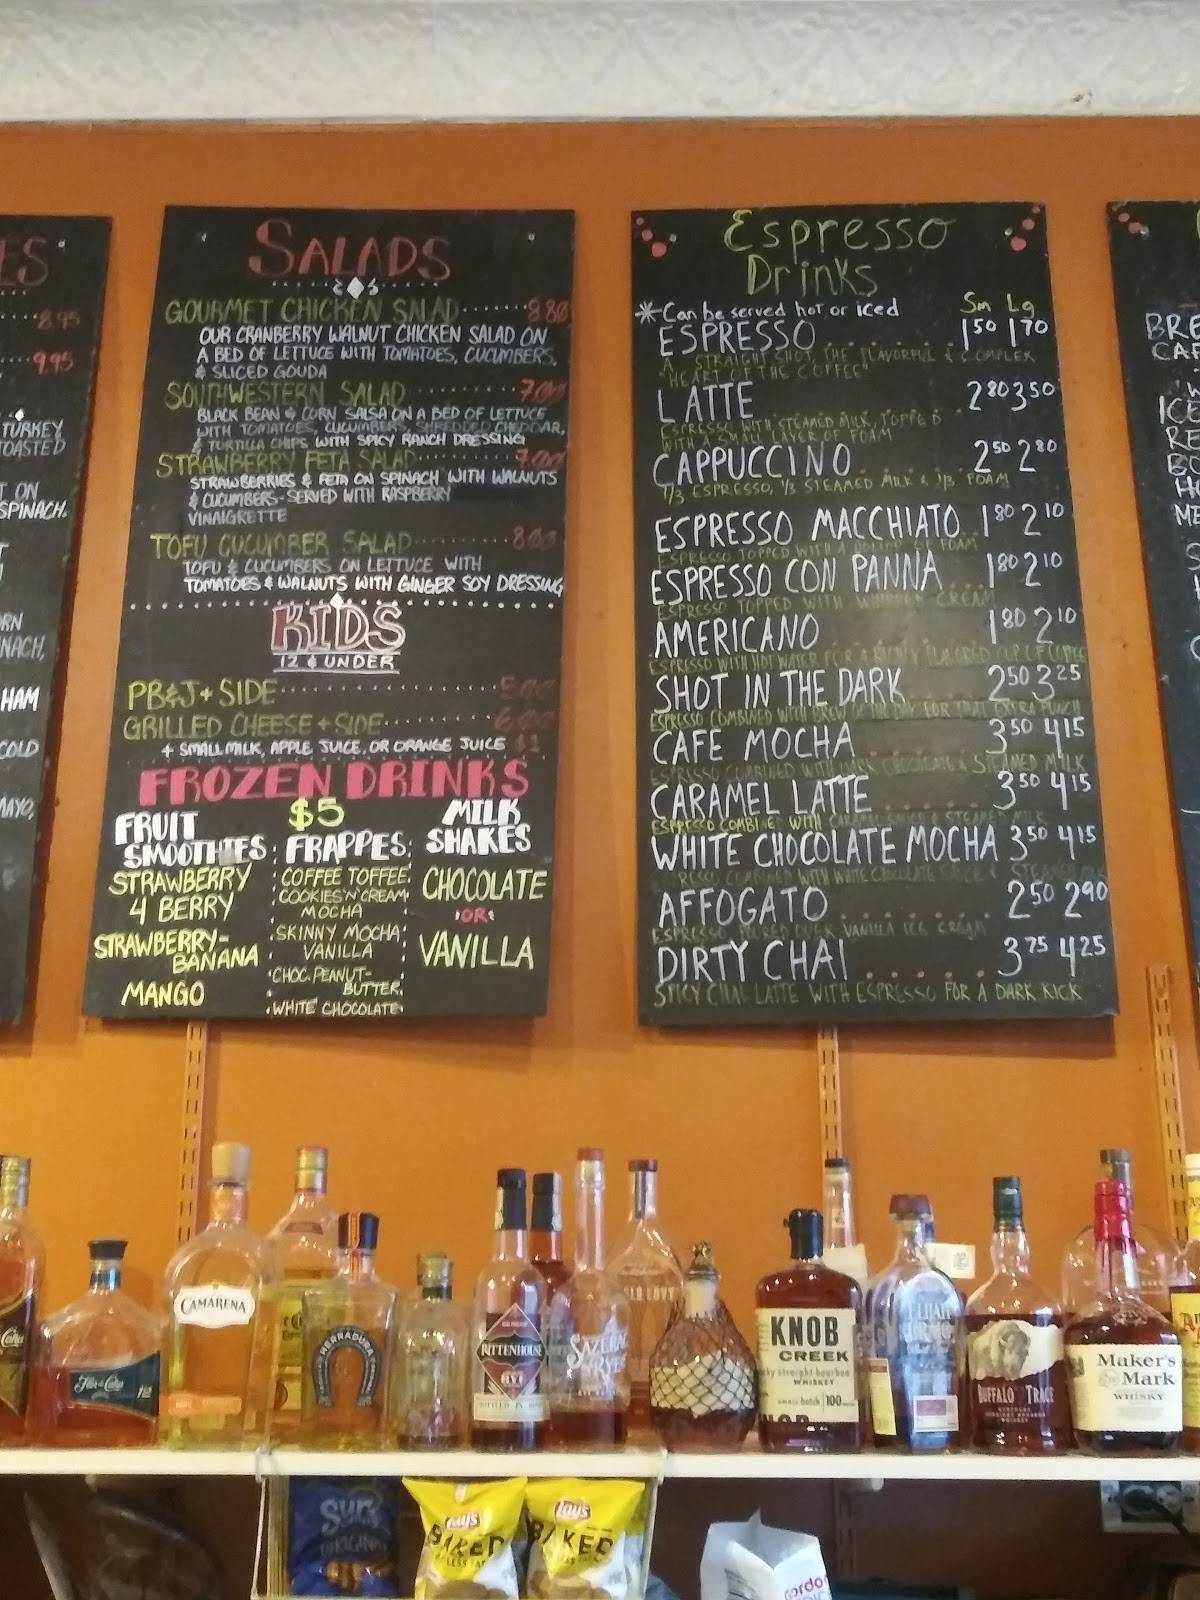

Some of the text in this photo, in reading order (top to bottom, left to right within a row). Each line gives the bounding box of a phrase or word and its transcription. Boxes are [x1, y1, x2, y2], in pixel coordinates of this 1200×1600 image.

[249, 217, 450, 281] SALADS
[723, 209, 957, 264] Espresso
[748, 253, 878, 298] Drinks
[165, 298, 271, 325] GOURMET
[280, 297, 384, 323] CHICKEN
[703, 301, 725, 320] be
[730, 302, 786, 318] served
[795, 301, 824, 317] hot
[830, 304, 848, 317] or
[856, 298, 900, 317] iced
[960, 291, 1035, 319] Sm Lg
[200, 324, 548, 347] OUR CRANBERRY WALNUT CHICKEN SALAD ON
[659, 320, 816, 357] ESPRESSO
[214, 345, 558, 367] BED LETTUCE WITH TOMATOES, CUCUMBERS,
[211, 365, 328, 380] SLICED GOUDA
[165, 380, 406, 410] SOUTHWESTERN SALAD
[658, 381, 754, 423] LATTE
[357, 433, 526, 448] SPICY RANCH DRESSING
[156, 452, 296, 479] STRAWBERRY
[305, 450, 351, 476] FETA
[653, 441, 851, 487] CAPPUCCINO
[190, 469, 558, 490] STRAWBERRIES FETA ON SPINACH WITH WALNUTS
[287, 485, 451, 505] SERVED WITH RASPBERRY
[188, 509, 288, 526] VINAIGRETTE
[655, 503, 960, 553] ESPRESSO MACCHIATO
[150, 530, 413, 560] TOFU CUCUMBER SALAD
[183, 555, 482, 576] TOFU CUCUMBERS ON LETTUCE WITH
[651, 549, 943, 606] ESPRESSO CON PANNA
[184, 574, 563, 598] TOMATOES WALNUTS WITH GINGER SOY DRESSING
[271, 602, 406, 652] KIDS
[655, 613, 820, 659] AMERICANO
[324, 654, 395, 670] UNDER
[0, 687, 40, 711] HAM
[128, 677, 278, 710] PB&J SIDE
[654, 667, 906, 714] SHOT IN THE DARK
[123, 711, 384, 740] GRILLED CHEESE SIDE
[180, 741, 222, 757] SMALL
[271, 740, 313, 755] APPLE
[319, 739, 366, 755] JUICE,
[370, 739, 389, 754] OR
[394, 737, 452, 752] ORANGE
[460, 736, 506, 751] JUICE
[653, 721, 856, 765] CAFE MOCHA
[139, 758, 529, 806] FROZEN DRINKS
[651, 774, 872, 820] CARAMEL LATTE
[288, 797, 345, 831] $5
[442, 798, 521, 826] MILK
[115, 811, 198, 845] FRUIT
[426, 823, 531, 856] SHAKES
[123, 834, 267, 869] SMOOTHIES
[286, 830, 407, 864] FRAPPES
[651, 823, 999, 871] WHITE CHOCOLATE MOCHA
[108, 862, 252, 896] STRAWBERRY
[281, 866, 408, 887] COFFEE TOFFEE
[422, 866, 548, 902] CHOCOLATE
[129, 891, 234, 925] 4 BERRY
[301, 903, 363, 919] MOCHA
[659, 886, 828, 928] AFFOGATO
[276, 921, 400, 942] SKINNY MOCHA
[172, 944, 259, 974] BANANA
[303, 943, 373, 960] VANILLA
[419, 930, 534, 970] VANILLA
[658, 938, 847, 984] DIRTY CHAI
[121, 981, 205, 1008] MANGO
[273, 997, 400, 1017] WHITE CHOCOLATE
[809, 982, 850, 1004] WITH
[945, 984, 971, 1001] FOR
[995, 983, 1035, 1001] DARK
[1043, 982, 1083, 1001] KICK
[180, 1297, 247, 1316] CAMARENA
[770, 1316, 839, 1348] KNOB
[779, 1350, 849, 1362] CREEK
[1097, 1354, 1176, 1367] Maker's
[1123, 1372, 1176, 1386] Mark
[826, 1395, 842, 1407] 100
[1113, 1393, 1164, 1401] WHISKY
